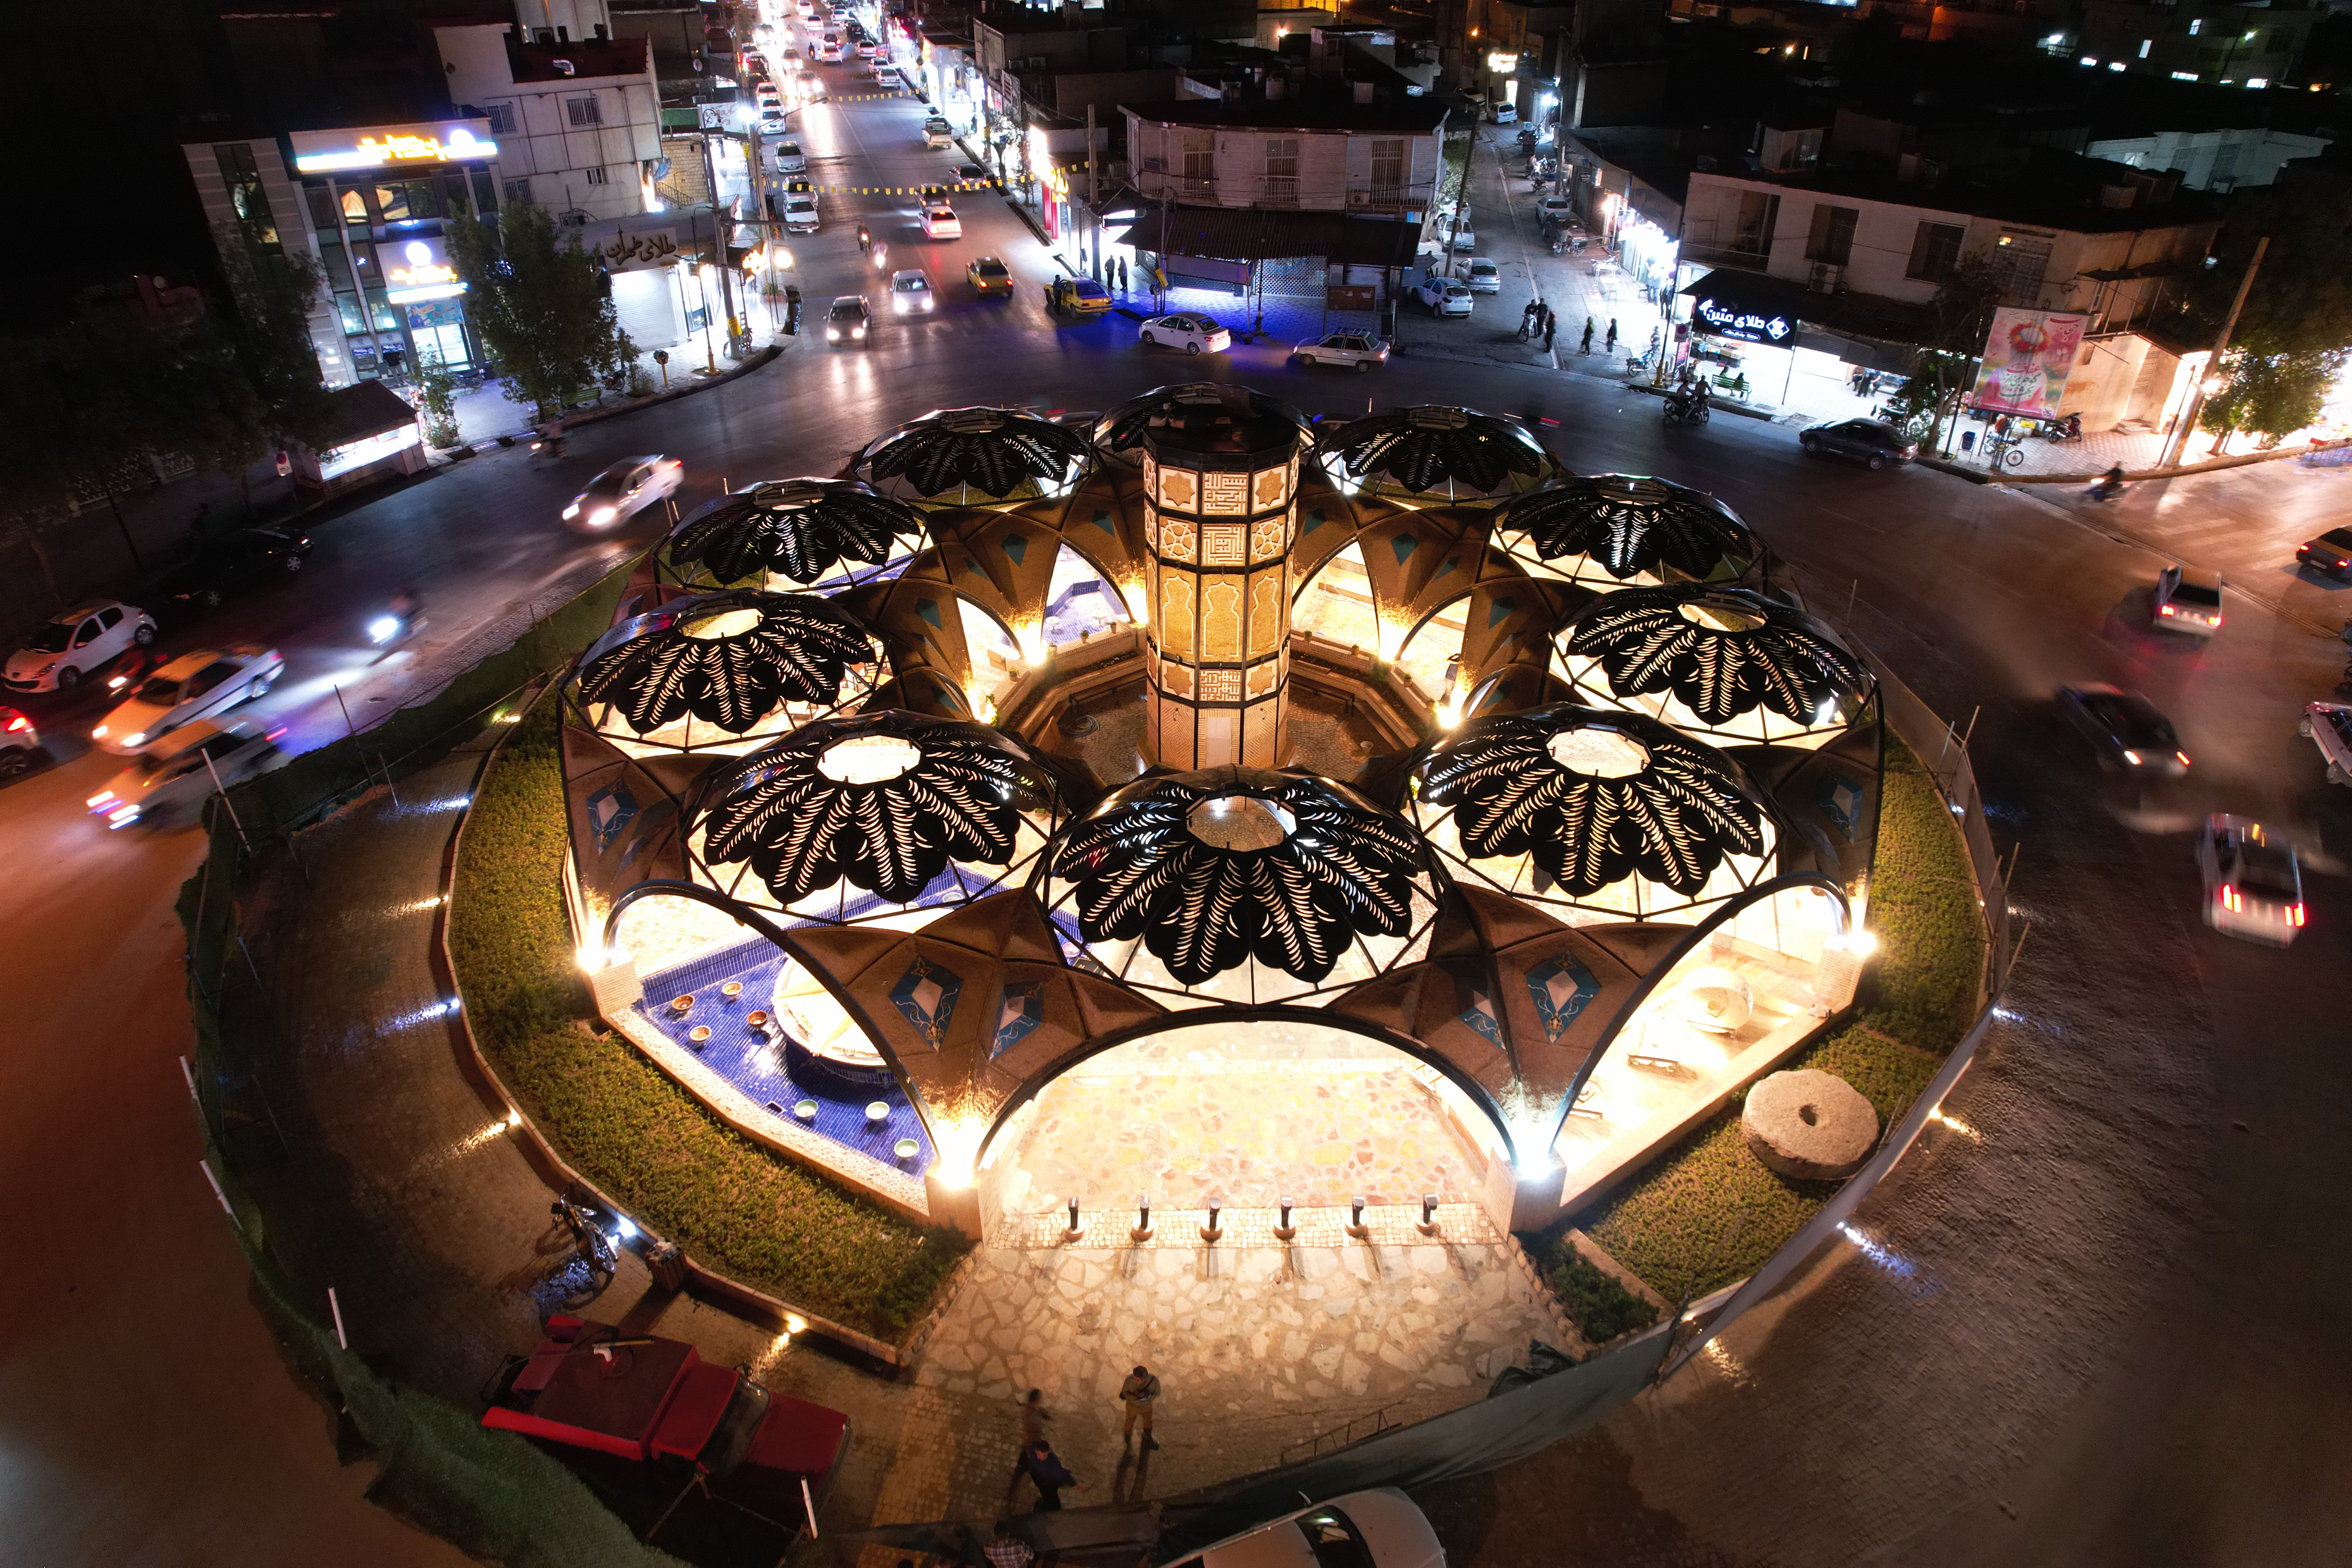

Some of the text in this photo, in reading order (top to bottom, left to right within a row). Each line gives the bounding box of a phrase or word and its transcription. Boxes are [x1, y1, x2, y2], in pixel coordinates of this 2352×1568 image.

[606, 224, 676, 266] طلای طهران
[1706, 308, 1765, 329] طلای متین
